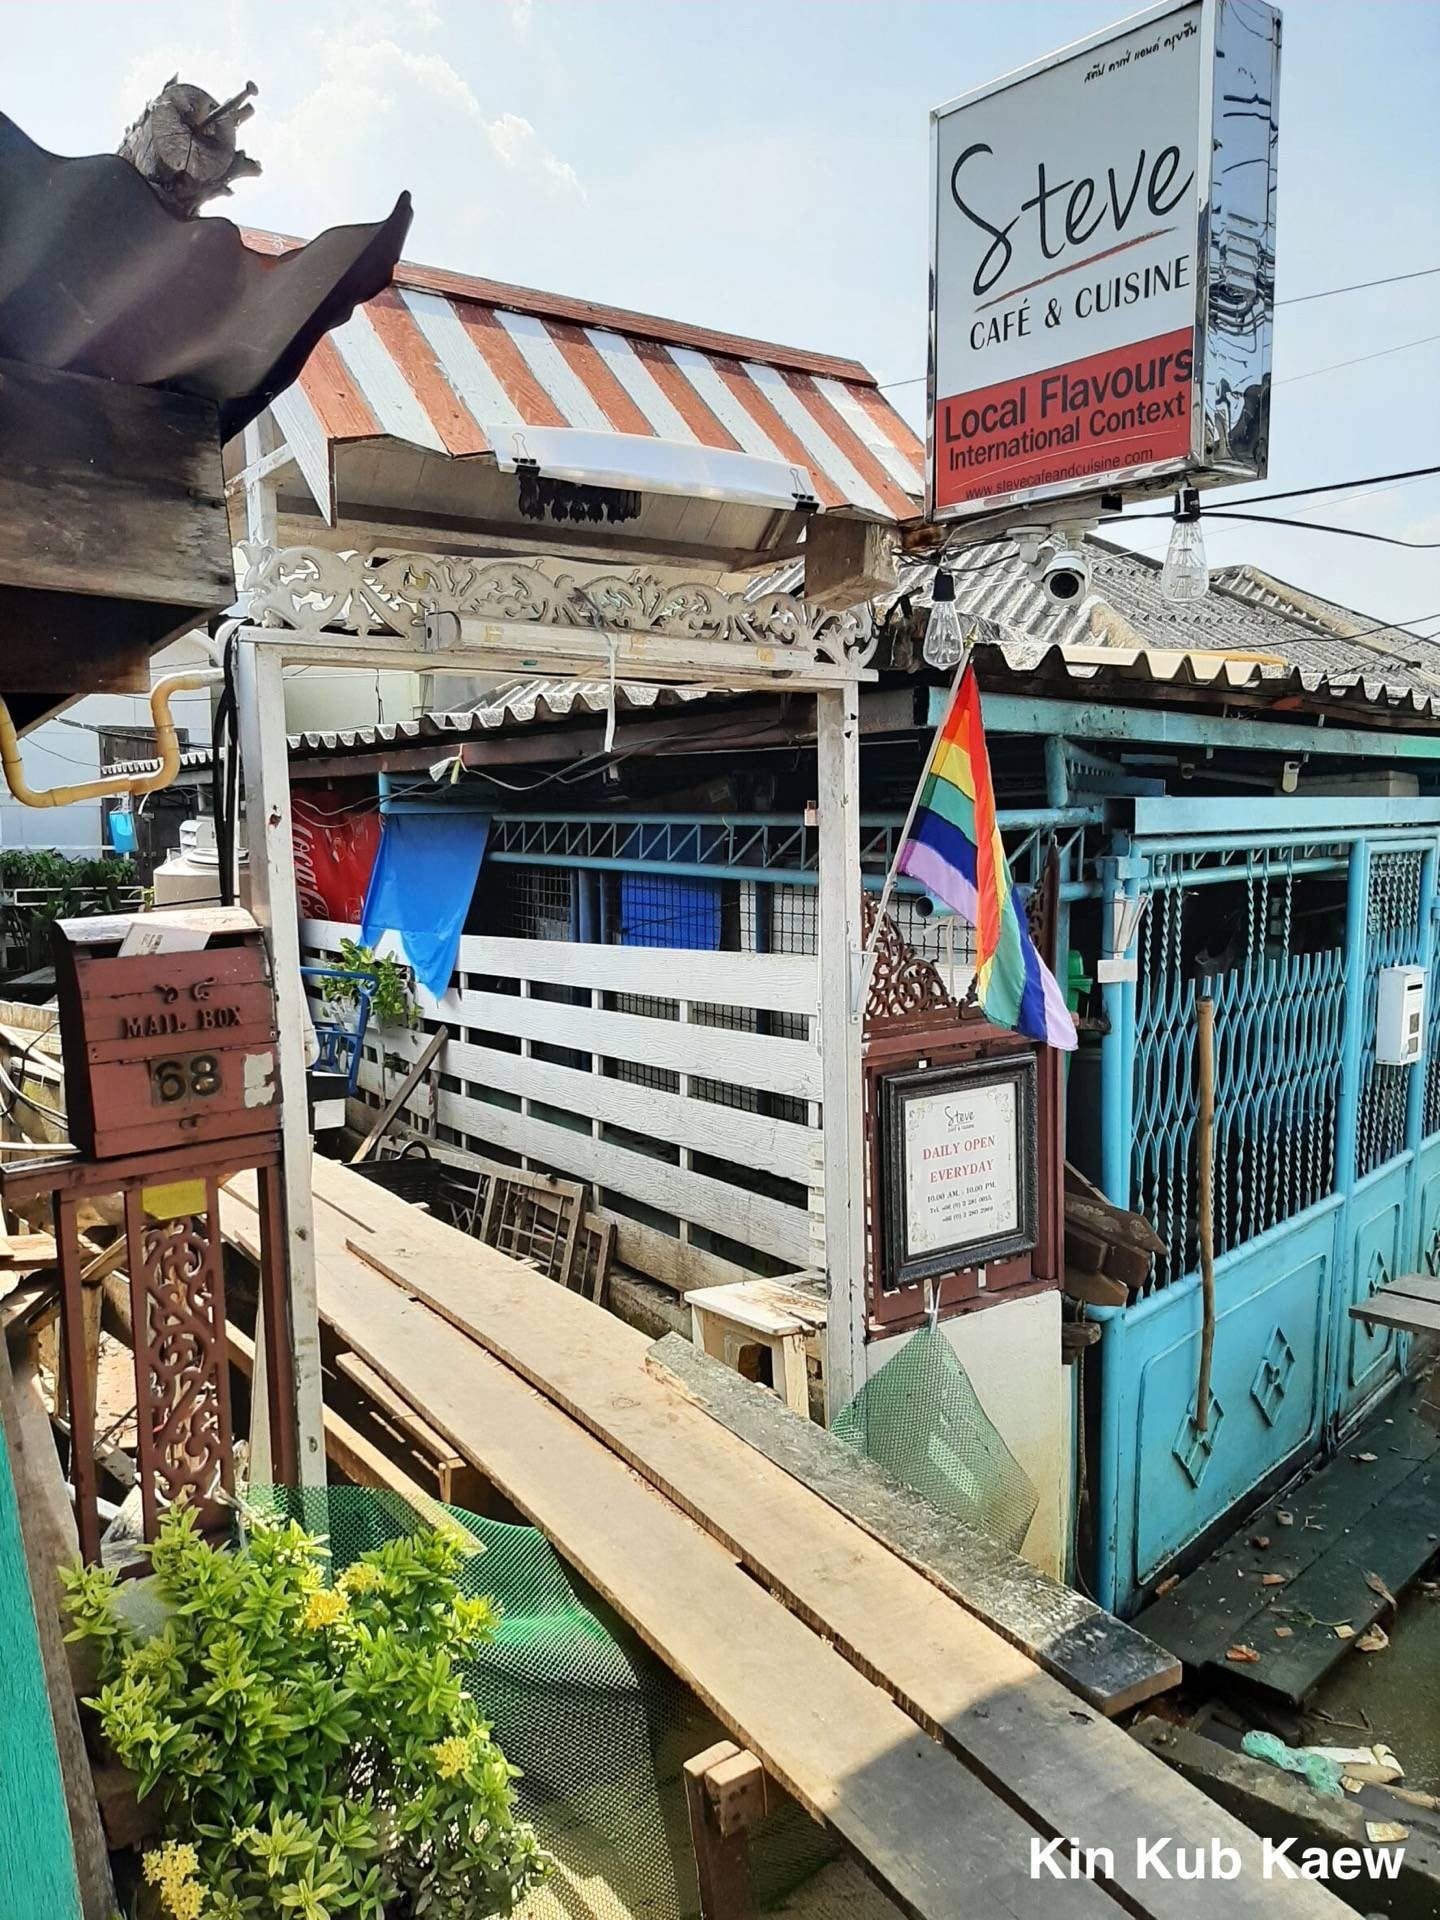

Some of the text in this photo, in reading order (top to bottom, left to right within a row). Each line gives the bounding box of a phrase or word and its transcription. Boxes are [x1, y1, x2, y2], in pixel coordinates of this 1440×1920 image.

[951, 143, 1194, 296] Steve
[970, 254, 1190, 350] CAFÉ & CUISINE
[945, 349, 1193, 443] Local Flavours
[950, 391, 1185, 471] International Context
[965, 447, 1154, 500] www.stevecafeandcuisine.com
[121, 1005, 242, 1039] MAIL BOX
[154, 1053, 223, 1102] 68
[944, 1105, 976, 1127] Steve
[923, 1135, 996, 1161] DAILY OPEN
[929, 1159, 996, 1184] EVERYDAY
